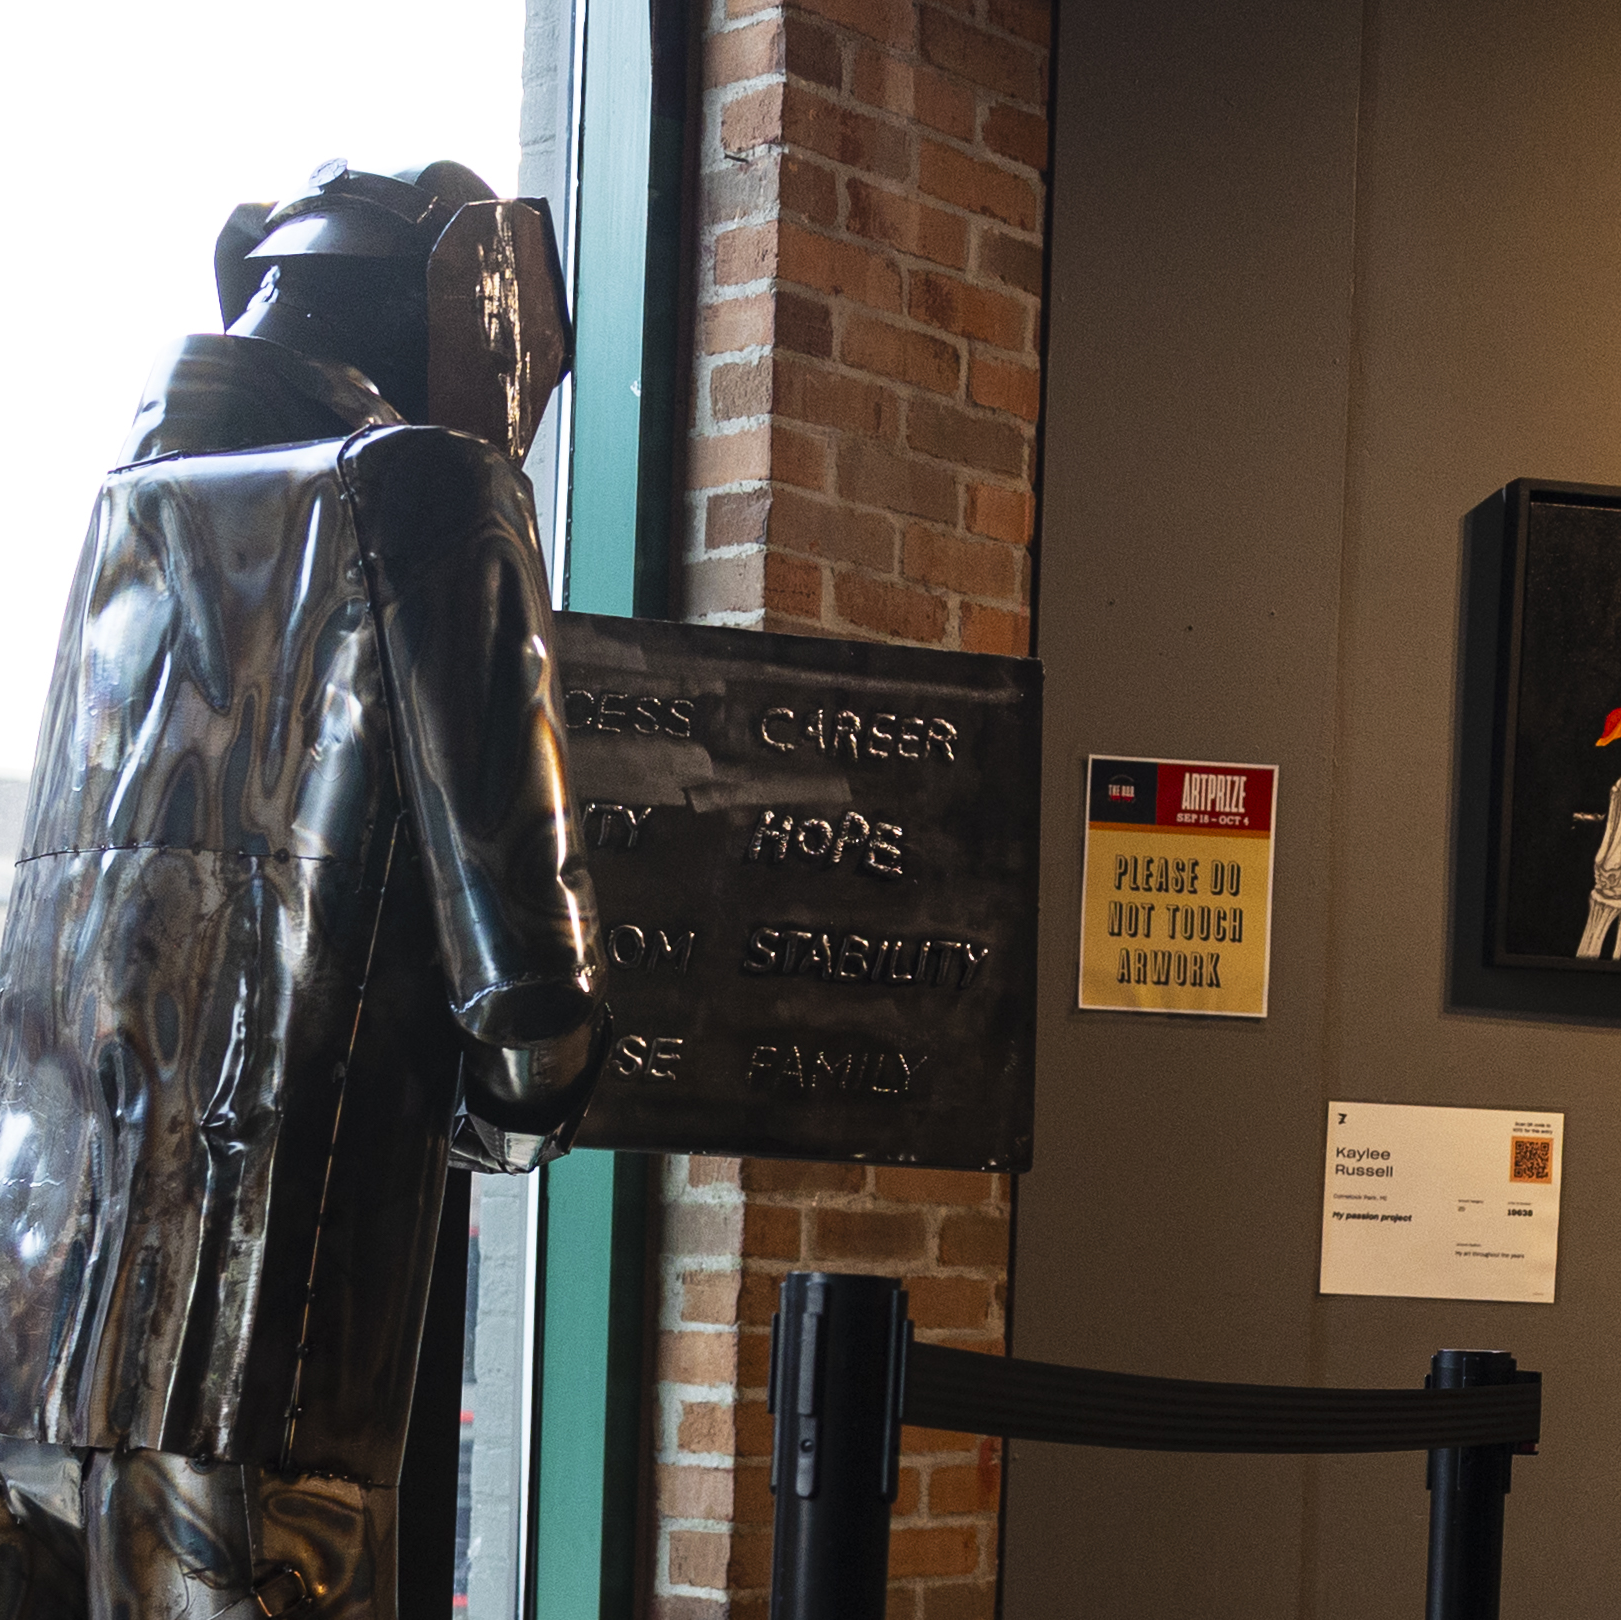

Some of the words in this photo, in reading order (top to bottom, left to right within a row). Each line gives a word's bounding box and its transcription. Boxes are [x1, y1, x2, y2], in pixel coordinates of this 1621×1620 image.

[761, 706, 959, 762] CAREER
[1181, 772, 1247, 814] ARTPRIZE
[748, 810, 904, 875] HOPE
[1114, 854, 1200, 894] PLEASE
[1210, 860, 1242, 897] DO
[1108, 901, 1155, 938] NOT
[1166, 903, 1244, 943] TOUCH
[743, 926, 989, 987] STABILITY
[1116, 947, 1222, 988] ARWORK
[746, 1045, 928, 1093] FAMILY
[1335, 1163, 1394, 1178] Russell
[1336, 1146, 1391, 1163] Kaylee
[1332, 1211, 1345, 1221] My
[1345, 1212, 1380, 1221] passion
[1380, 1213, 1413, 1224] project
